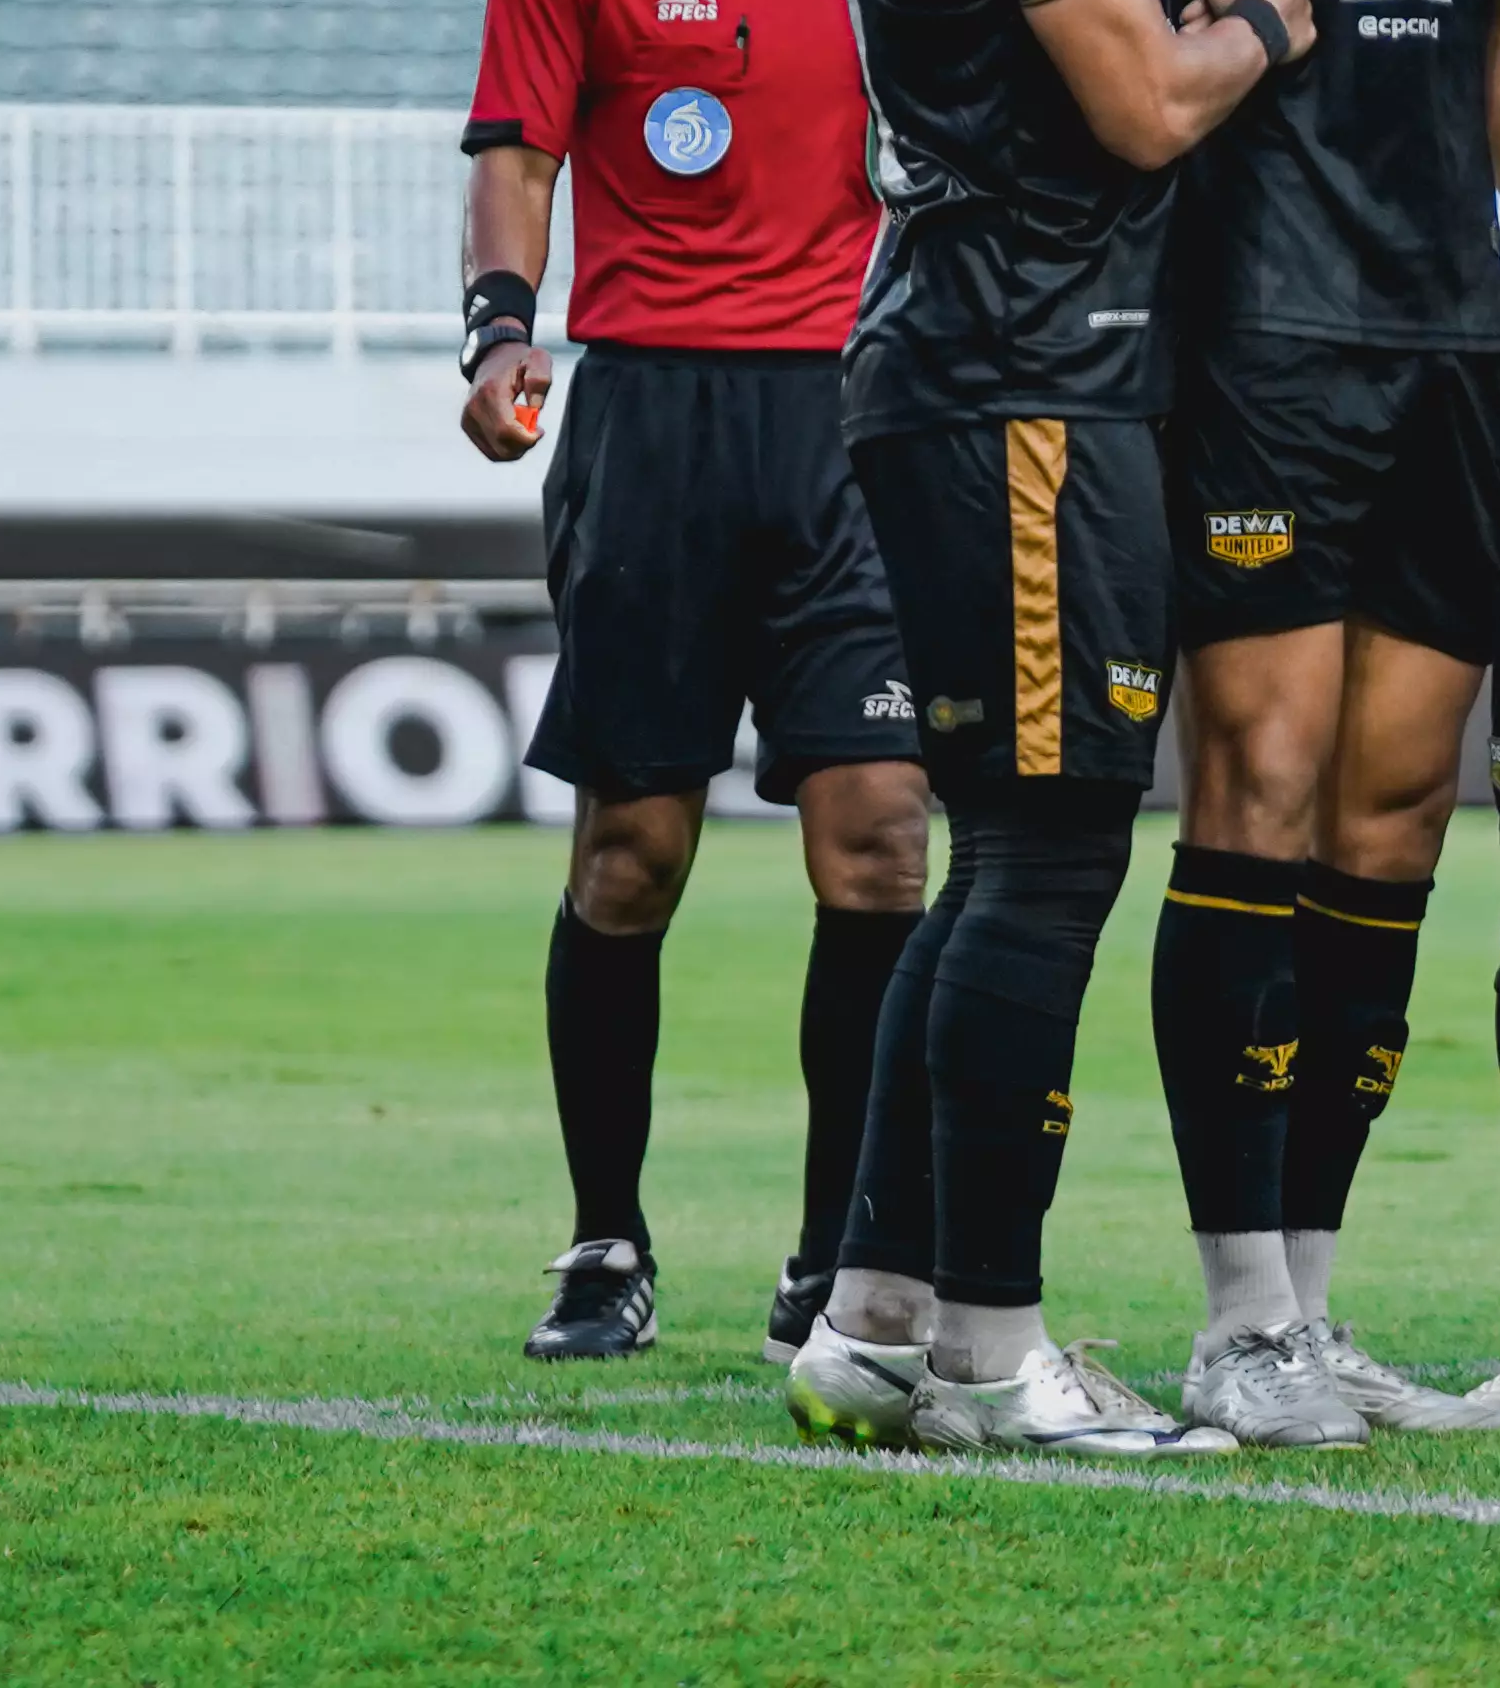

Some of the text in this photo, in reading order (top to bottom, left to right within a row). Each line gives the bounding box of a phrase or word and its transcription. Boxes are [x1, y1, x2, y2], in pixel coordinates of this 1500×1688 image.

[657, 3, 719, 21] SPECS
[1208, 513, 1288, 535] DEWA
[1224, 537, 1275, 556] UNITED
[1110, 664, 1156, 692] DEWA
[1355, 1075, 1394, 1094] DR
